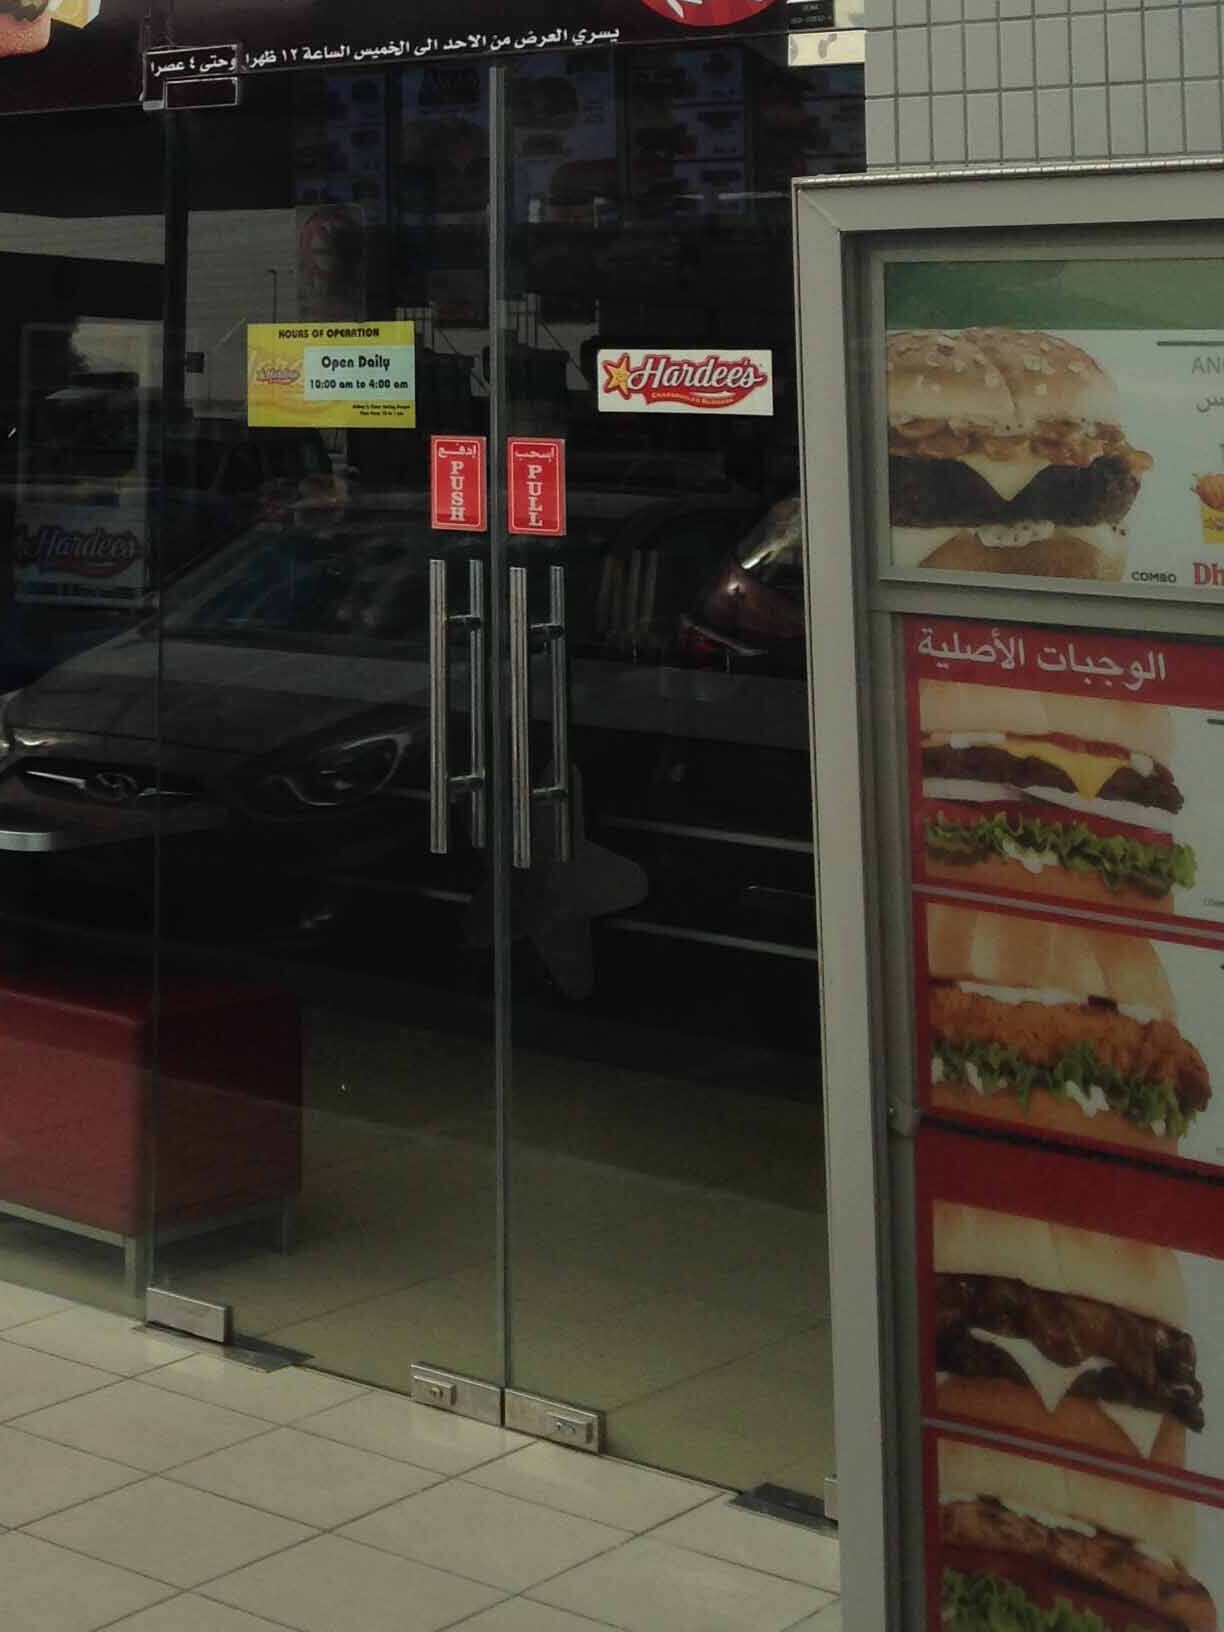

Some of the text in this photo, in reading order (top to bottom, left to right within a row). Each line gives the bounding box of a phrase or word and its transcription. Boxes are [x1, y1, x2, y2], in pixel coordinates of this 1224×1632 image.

[442, 34, 487, 50] الاحد
[490, 34, 511, 51] من
[514, 28, 568, 48] العرض
[571, 27, 620, 47] يسري
[302, 44, 351, 60] الساعة
[353, 40, 410, 61] الخميس
[413, 38, 438, 56] الى
[244, 49, 277, 68] ظهرا
[150, 60, 186, 77] عصرا
[278, 328, 380, 339] HOURS OF OPERATION
[321, 354, 391, 371] Open Daily
[627, 357, 764, 389] Hardee's
[309, 379, 336, 390] 10:00
[338, 381, 353, 389] am
[355, 379, 366, 389] to
[368, 378, 391, 389] 4:00
[449, 460, 466, 522] PUSH
[526, 464, 543, 527] PULL
[1131, 570, 1177, 584] COMBO
[916, 627, 1167, 691] الوجبات الأصلية
